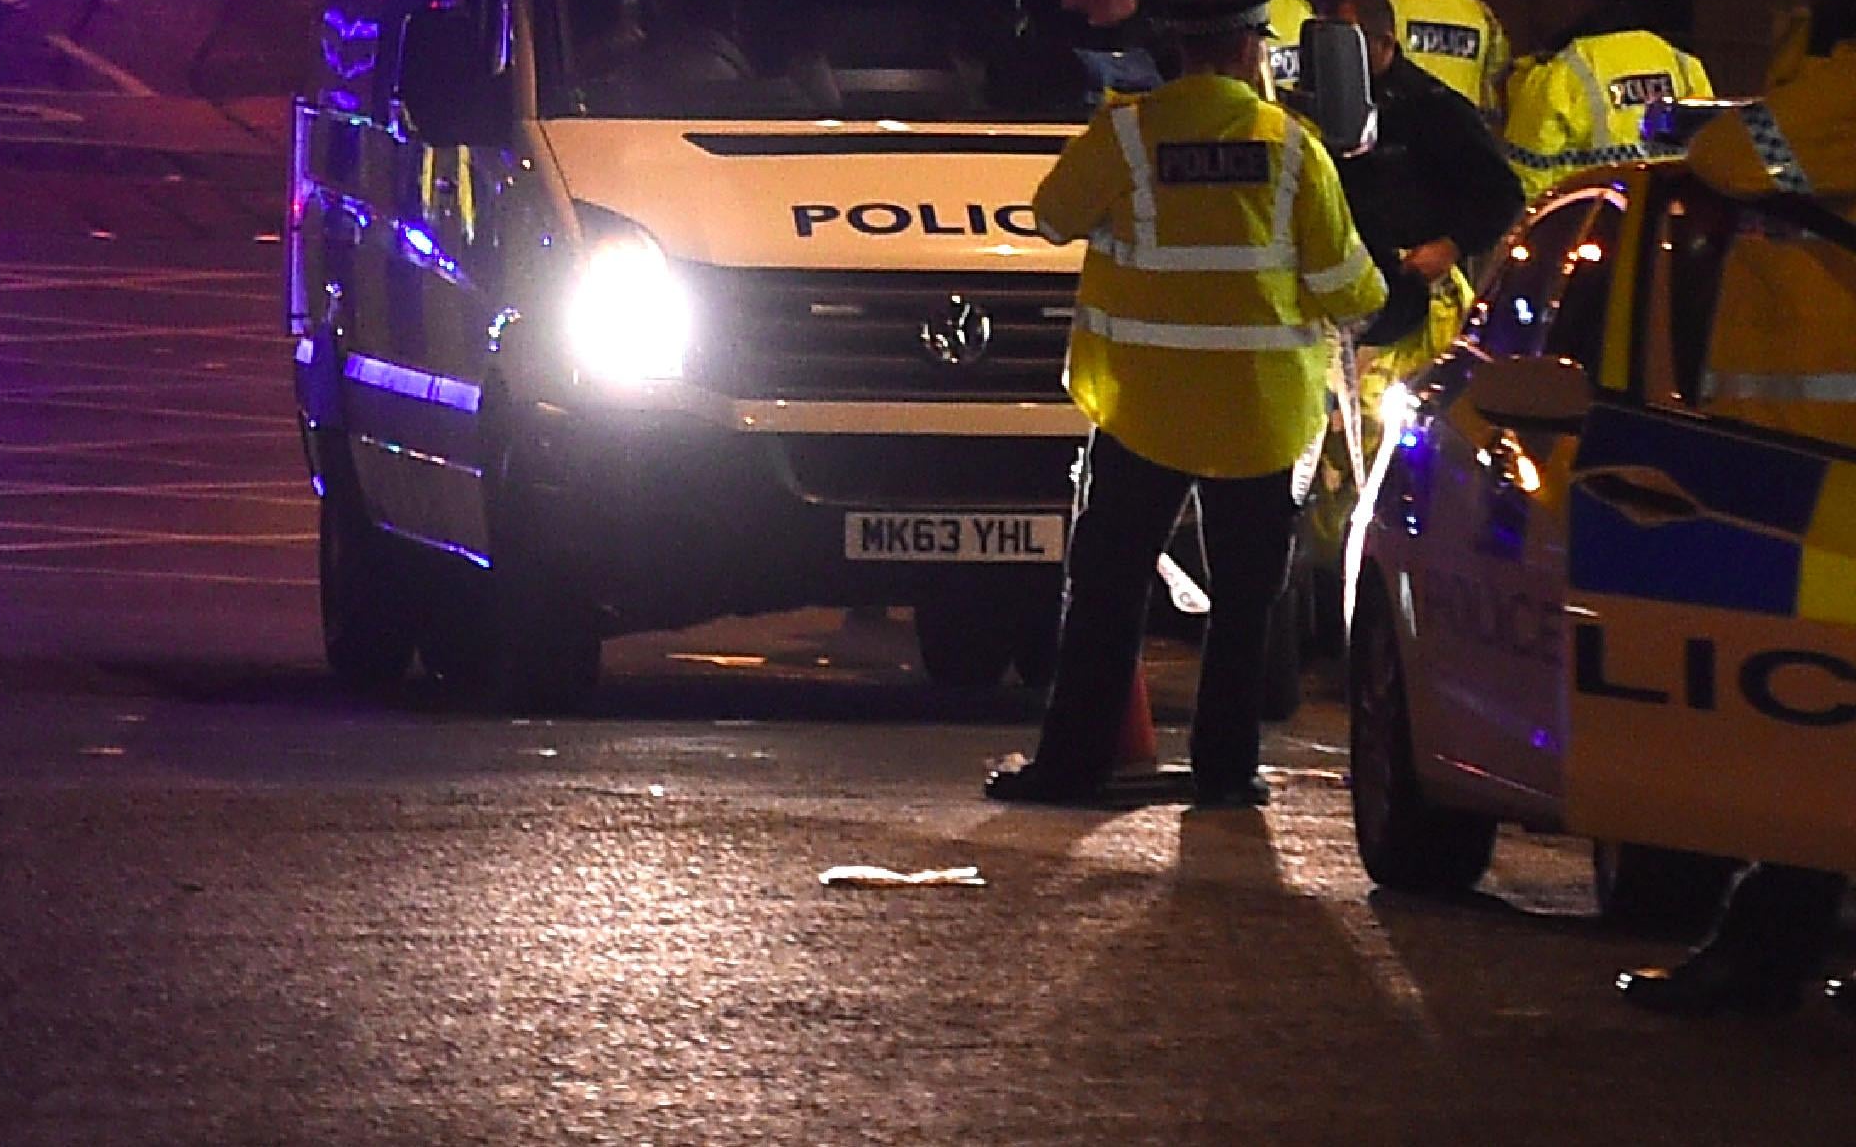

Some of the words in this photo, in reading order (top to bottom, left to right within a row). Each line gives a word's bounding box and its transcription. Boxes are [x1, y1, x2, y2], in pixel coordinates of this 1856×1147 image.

[1408, 25, 1478, 57] POLICE
[1609, 75, 1672, 105] POLICE
[1162, 147, 1266, 180] POLICE
[792, 203, 1040, 239] POLIC
[862, 518, 960, 552] MK63
[974, 519, 1044, 553] YHL
